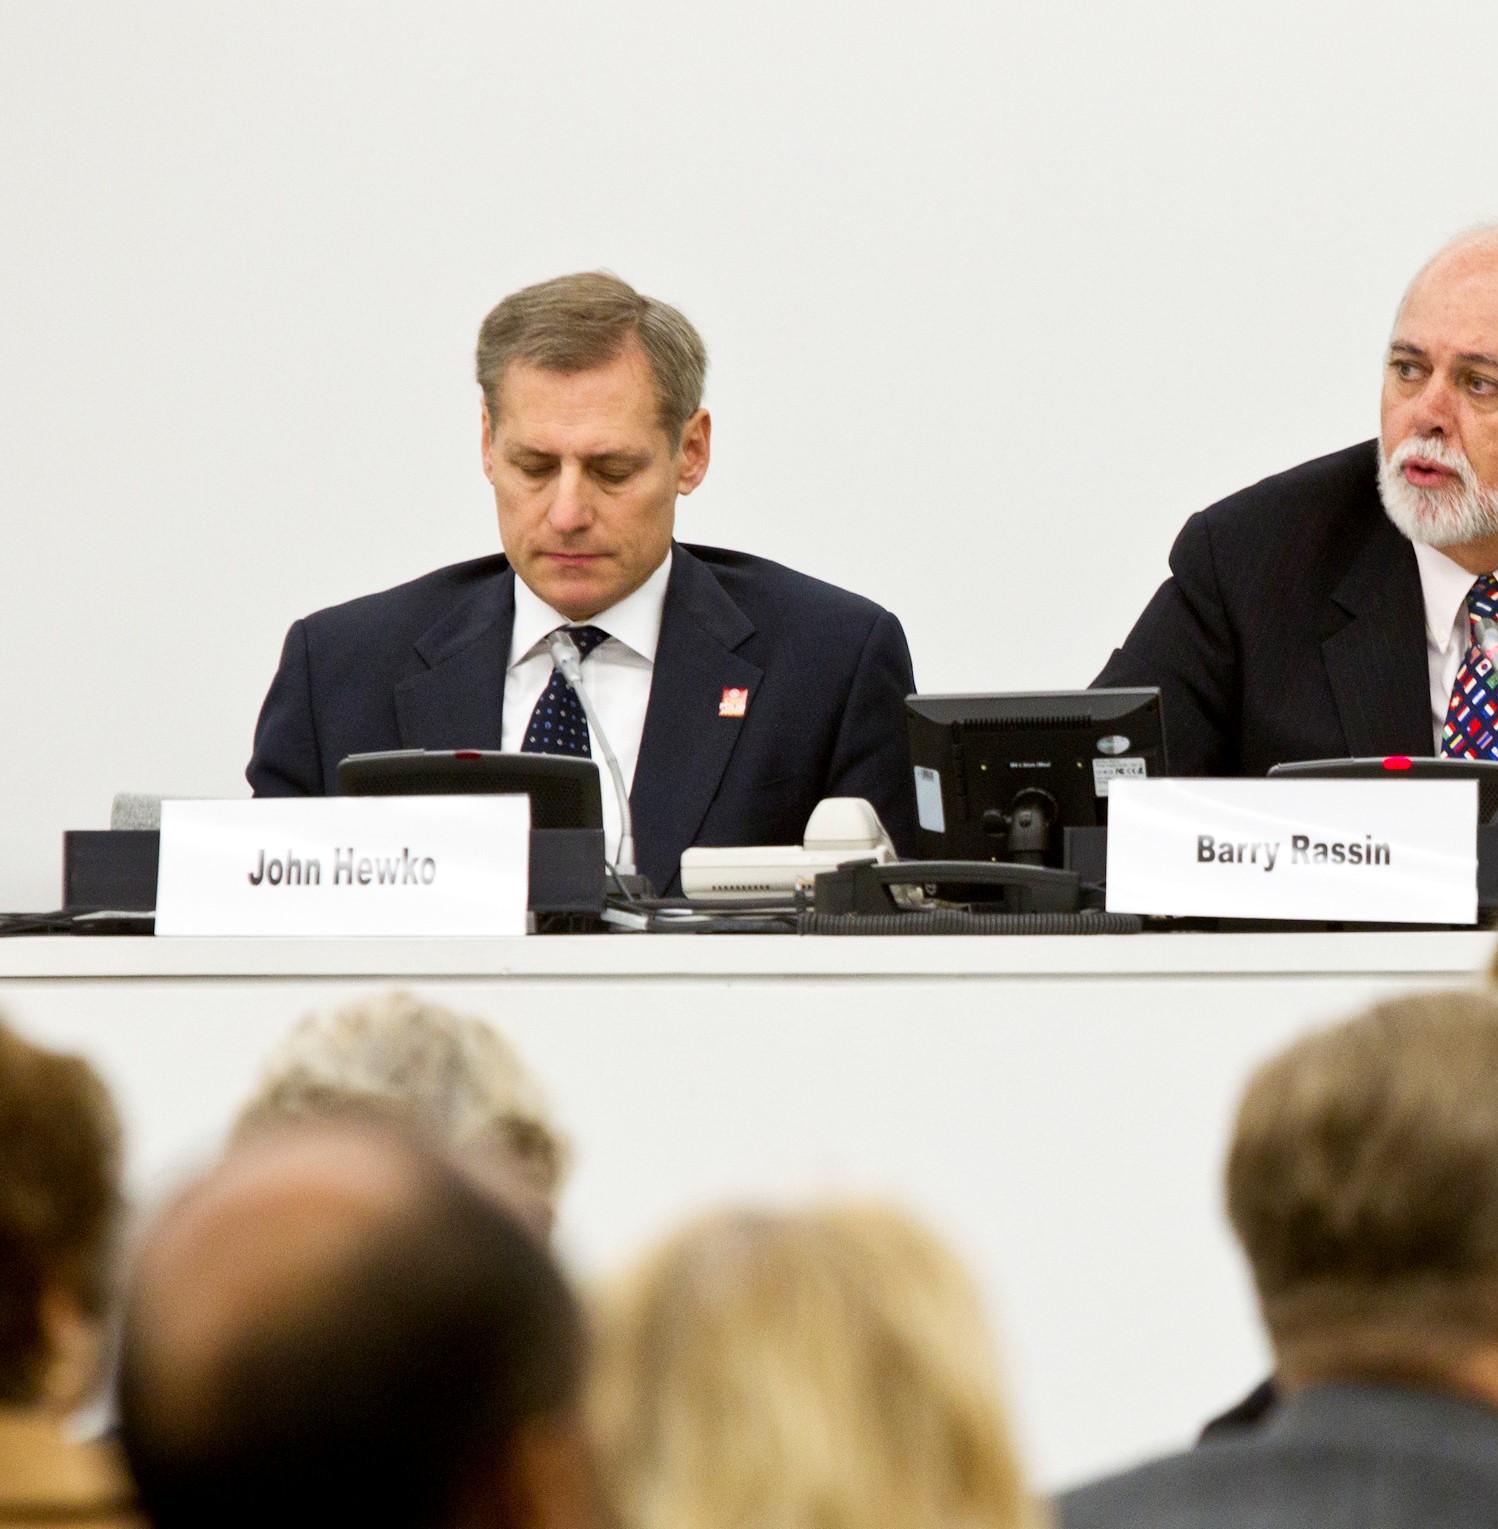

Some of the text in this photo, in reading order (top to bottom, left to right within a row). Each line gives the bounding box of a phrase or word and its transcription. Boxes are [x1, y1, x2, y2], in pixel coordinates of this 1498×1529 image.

[248, 848, 436, 885] John Hewko
[1197, 834, 1391, 872] Barry Rassin
